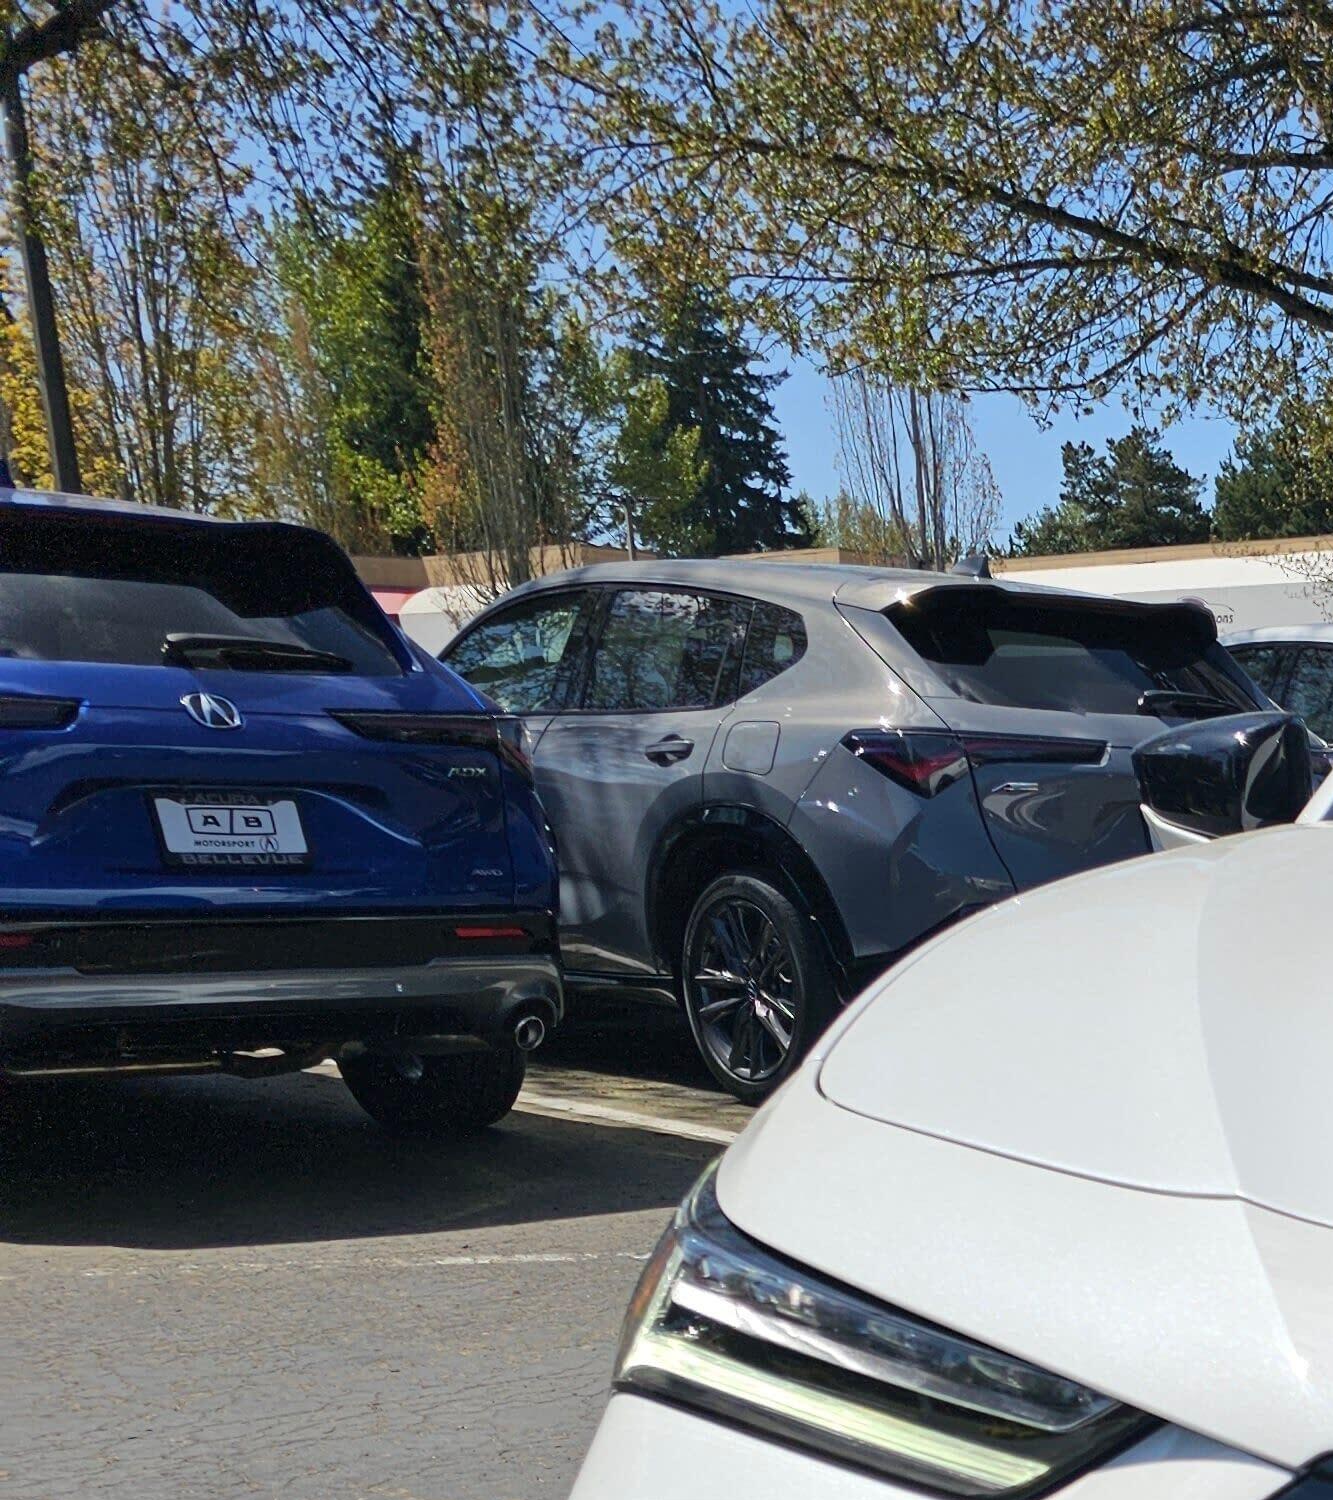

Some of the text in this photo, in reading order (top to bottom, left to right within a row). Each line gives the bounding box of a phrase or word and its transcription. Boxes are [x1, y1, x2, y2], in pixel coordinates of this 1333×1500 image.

[193, 793, 259, 804] ACURA
[202, 814, 263, 828] A B
[194, 838, 255, 848] MOTORSPORT
[180, 853, 305, 865] BELLEVUE
